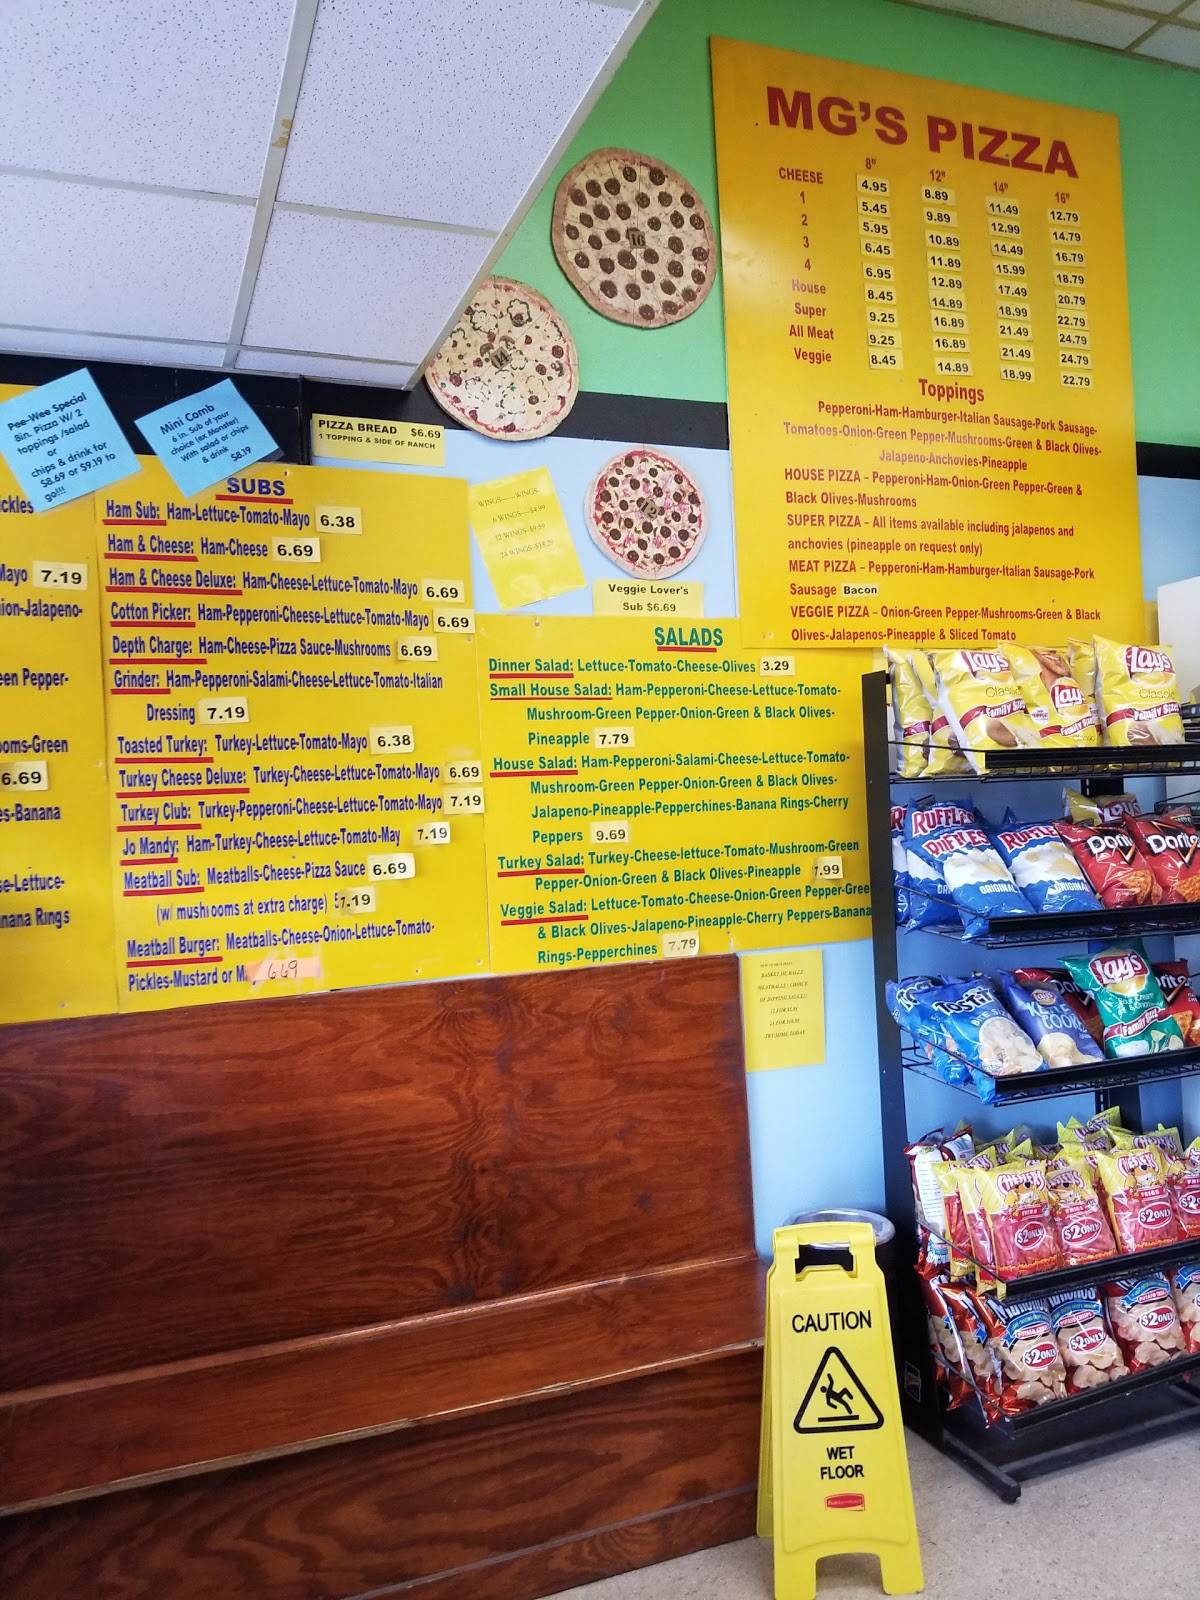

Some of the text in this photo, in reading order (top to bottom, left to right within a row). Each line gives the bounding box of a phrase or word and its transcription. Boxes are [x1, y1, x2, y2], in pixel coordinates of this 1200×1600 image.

[766, 86, 1079, 178] MG'S PIZZA
[779, 167, 824, 184] CHEESE
[861, 181, 887, 193] 4.95
[800, 193, 805, 203] 1
[924, 189, 949, 201] 8.89
[862, 202, 887, 214] 5.45
[989, 203, 1018, 215] 11.49
[801, 214, 808, 226] 2
[926, 211, 951, 223] 9.89
[1049, 211, 1079, 223] 12.79
[863, 223, 888, 235] 5.95
[991, 223, 1020, 235] 12.99
[803, 237, 809, 248] 3
[929, 235, 959, 247] 10.89
[1052, 231, 1081, 242] 14.79
[865, 243, 891, 255] 6.45
[994, 244, 1023, 256] 14.49
[930, 257, 961, 269] 11.89
[1055, 252, 1084, 263] 16.79
[804, 259, 811, 271] 4
[996, 264, 1025, 276] 15.99
[866, 268, 891, 279] 6.95
[1056, 273, 1084, 285] 18.79
[792, 280, 826, 294] House
[931, 277, 962, 289] 12.89
[998, 285, 1027, 297] 17.49
[1058, 294, 1085, 306] 20.79
[794, 303, 826, 319] Super
[789, 325, 834, 340] All Meat
[794, 347, 832, 364] Veggie
[919, 378, 985, 404] Toppings
[7, 391, 87, 430] Pee-Wee Special
[160, 403, 215, 435] Mini Comb
[818, 401, 1097, 436] Pepperoni-Ham-Hamburger-Italian Sausage-Pork Sausage-
[13, 429, 32, 442] 8in.
[33, 420, 57, 435] Pizza
[318, 419, 441, 439] PIZZA BREAD $6.69
[326, 433, 362, 443] TOPPING
[375, 437, 394, 445] SIDE
[408, 441, 436, 449] RANCH
[230, 447, 252, 463] $8.19
[880, 450, 1028, 472] Jalapeno-Anchovies-Pineapple
[226, 475, 286, 496] SUBS
[784, 468, 1082, 496] HOUSE PIZZA Pepperoni-Ham-Onion-Green Pepper-Green &
[786, 492, 917, 508] Black Olives-Mushrooms
[106, 499, 310, 529] Ham Sub: Ham-Lettuce-Tomato-Mayo
[320, 514, 355, 528] 6.38
[787, 514, 1074, 537] SUPER PIZZA All items available including jalapenos and
[107, 534, 268, 557] Ham & Cheese: Ham-Cheese
[277, 544, 313, 557] 6.69
[788, 539, 983, 557] anchovies (pineapple on request only)
[40, 570, 82, 585] 7.19
[609, 584, 689, 595] Veggie Lover's
[790, 583, 877, 596] Sausage Bacon
[623, 602, 676, 613] Sub $6.69
[110, 603, 429, 630] Cotton Picker: Ham-Pepperoni-Cheese-Lettuce-Tomato-Mayo
[437, 615, 470, 629] 6.69
[654, 627, 724, 646] SALADS
[791, 628, 1016, 642] Olives-Jalapenos-Pineapple & Sliced Tomato
[112, 636, 391, 657] Depth Charge: Ham-Cheese-Pizza Sauce-Mushrooms
[401, 644, 433, 657] 6.69
[489, 658, 756, 674] Dinner Salad: Lettuce-Tomato-Cheese-Olives
[762, 660, 789, 671] 3.29
[114, 670, 443, 690] Grinder: Ham-Pepperoni-Salami-Cheese-Lettuce-Tomato-Italian
[490, 683, 841, 699] Small House Salad: Ham-Pepperoni-Cheese-Lettuce-Tomato-
[146, 703, 196, 723] Dressing
[207, 706, 245, 720] 7.19
[118, 733, 368, 757] Toasted Turkey: Turkey-Lettuce-Tomato-Mayo
[377, 734, 411, 747] 6.38
[528, 731, 589, 747] Pineapple
[600, 733, 629, 745] 7.79
[1, 772, 42, 785] 6.69
[911, 807, 975, 837] RUFFLES
[417, 827, 448, 841] 7.19
[532, 829, 583, 845] Peppers
[596, 829, 626, 840] 9.69
[123, 827, 400, 858] Jo Mandy: Ham-Turkey-Cheese-Lettuce-Tomato-May
[668, 938, 696, 950] 7.79
[537, 943, 657, 965] Rings-Pepperchines
[792, 1310, 872, 1333] CAUTION
[827, 1446, 854, 1459] WET
[820, 1465, 864, 1480] FLOOR
